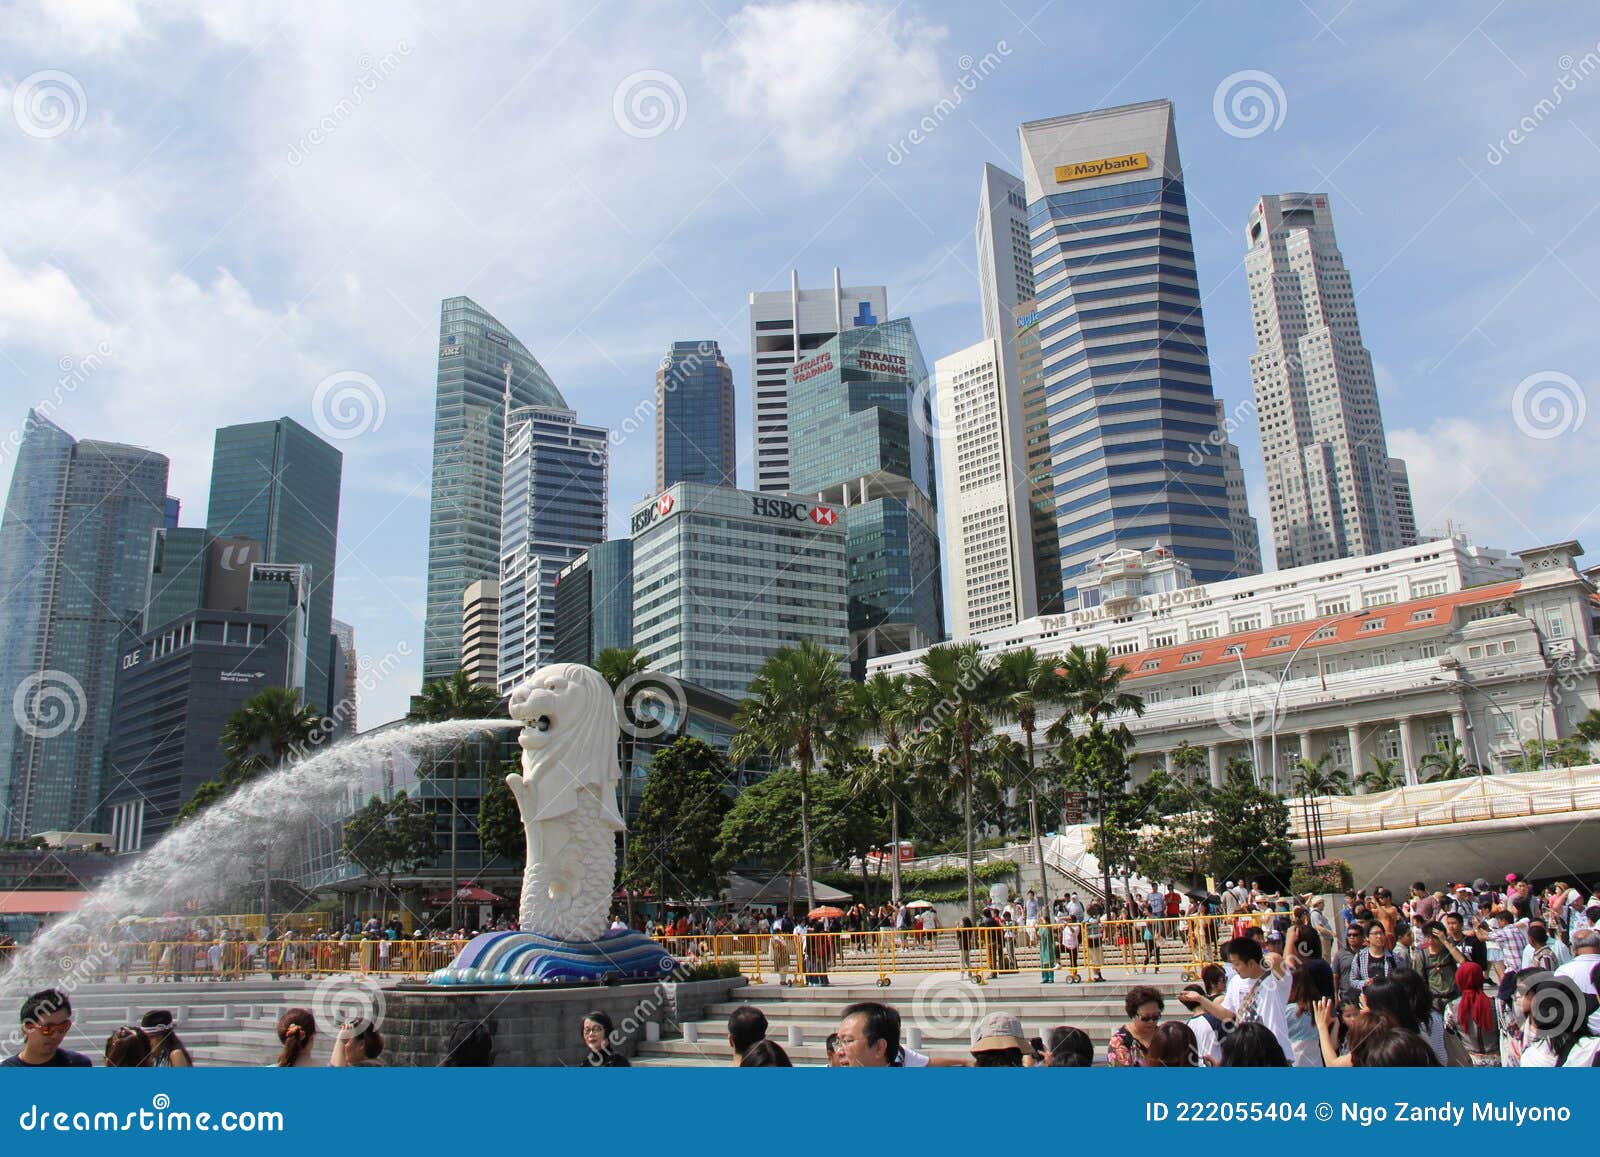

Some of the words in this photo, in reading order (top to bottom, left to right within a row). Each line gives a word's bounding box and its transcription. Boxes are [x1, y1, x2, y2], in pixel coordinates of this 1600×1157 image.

[1073, 156, 1139, 175] Maybank
[793, 352, 831, 375] STRAITS
[857, 359, 907, 375] TRADING
[859, 350, 906, 366] STRAITS
[793, 362, 833, 384] TRADING
[631, 503, 659, 535] HSBC
[752, 496, 808, 522] HSBC
[1040, 615, 1067, 632] THE
[1071, 599, 1154, 625] FULLERTON
[1158, 586, 1211, 608] HOTEL
